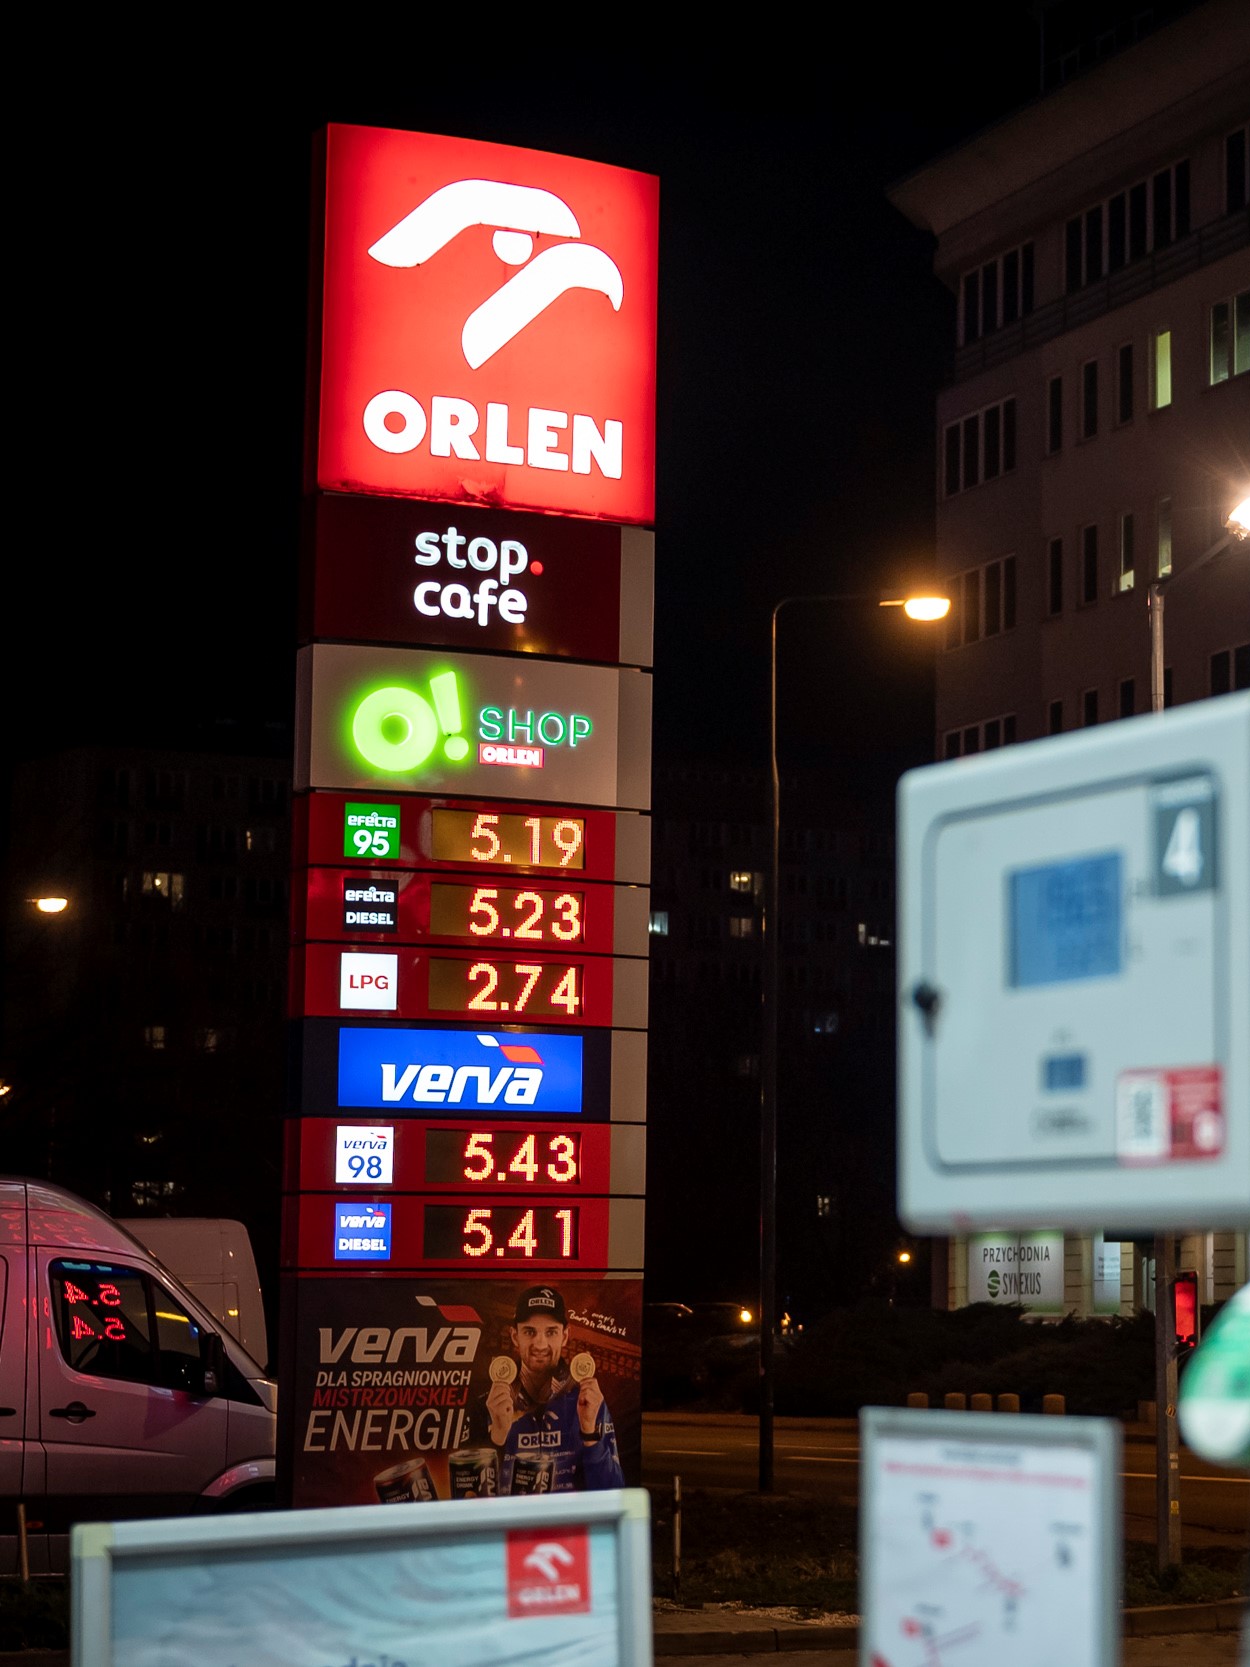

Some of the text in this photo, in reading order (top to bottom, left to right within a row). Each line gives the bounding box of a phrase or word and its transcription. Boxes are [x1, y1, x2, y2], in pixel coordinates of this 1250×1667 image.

[362, 389, 623, 480] ORLEN
[414, 579, 528, 627] cafe
[479, 707, 593, 747] SHOP
[482, 746, 540, 766] ORLEN
[353, 829, 390, 856] 95
[471, 814, 582, 866] 5.19
[1162, 806, 1204, 887] 4
[345, 911, 394, 925] DIESEL
[470, 889, 581, 941] 5.23
[349, 975, 389, 990] LPG
[468, 963, 579, 1014] 2.74
[381, 1064, 544, 1105] verva
[344, 1140, 387, 1150] verva
[464, 1134, 577, 1182] 5.43
[348, 1155, 382, 1179] 98
[340, 1215, 386, 1228] verva
[463, 1209, 572, 1257] 5.41
[338, 1238, 387, 1251] DIESEL
[983, 1246, 1050, 1263] PRZYCHODNIA
[1002, 1272, 1042, 1295] SYNEXUS
[319, 1327, 481, 1363] verva
[316, 1369, 471, 1388] DLA SPRAGNIONYCH
[313, 1387, 469, 1408] MISTRZOWSKIEJ
[303, 1408, 465, 1451] ENERGII
